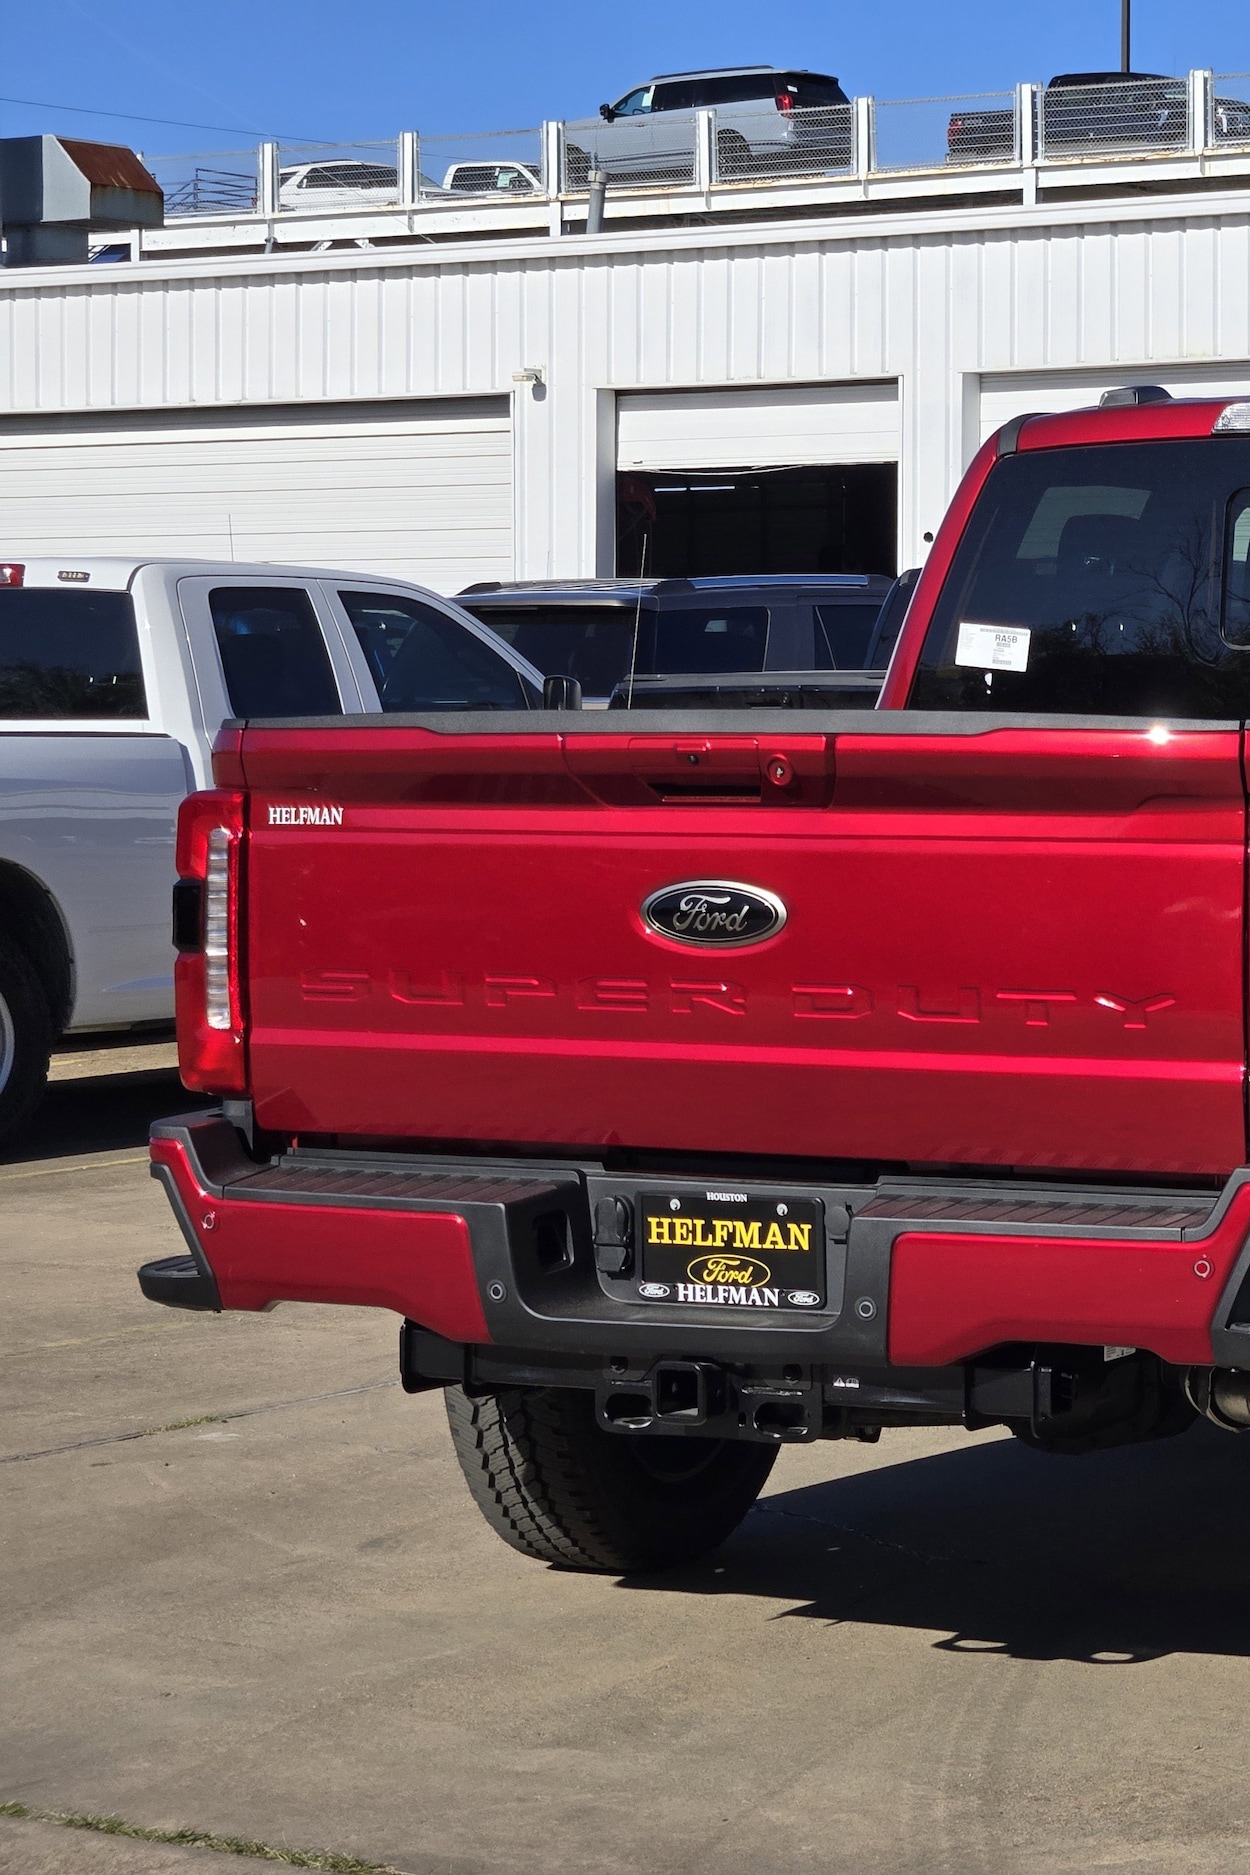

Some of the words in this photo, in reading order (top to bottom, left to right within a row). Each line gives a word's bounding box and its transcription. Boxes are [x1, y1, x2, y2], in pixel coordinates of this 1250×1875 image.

[994, 633, 1018, 643] RA5B
[268, 806, 344, 825] HELFMAN
[672, 894, 750, 932] Ford
[300, 967, 748, 1016] SUPER
[791, 982, 1176, 1030] DUTY
[706, 1191, 748, 1203] HOUSTON
[647, 1217, 812, 1251] HELFMAN
[702, 1257, 754, 1284] Ford
[676, 1283, 780, 1307] HELFMAN
